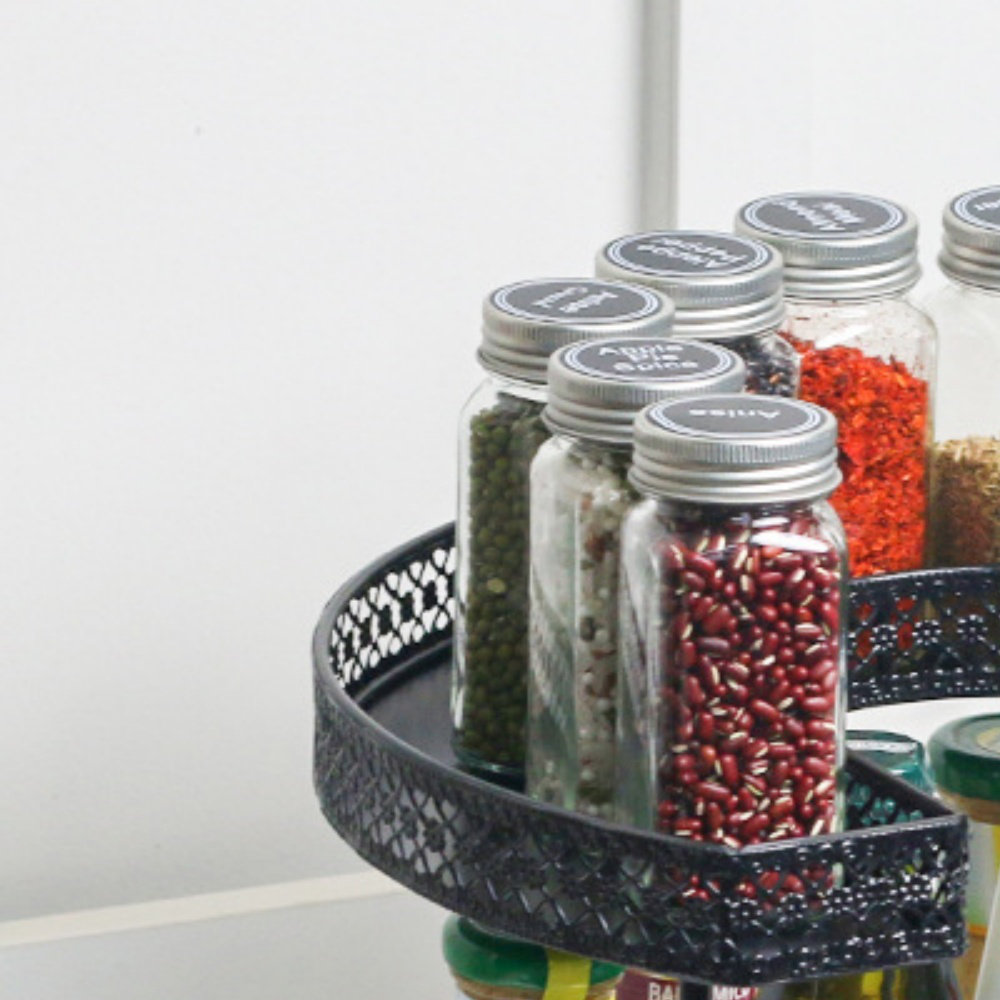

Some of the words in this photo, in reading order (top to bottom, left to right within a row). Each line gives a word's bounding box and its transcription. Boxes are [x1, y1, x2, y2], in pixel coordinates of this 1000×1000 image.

[599, 345, 683, 356] Apple
[613, 361, 698, 372] Spice
[689, 407, 781, 420] Anise
